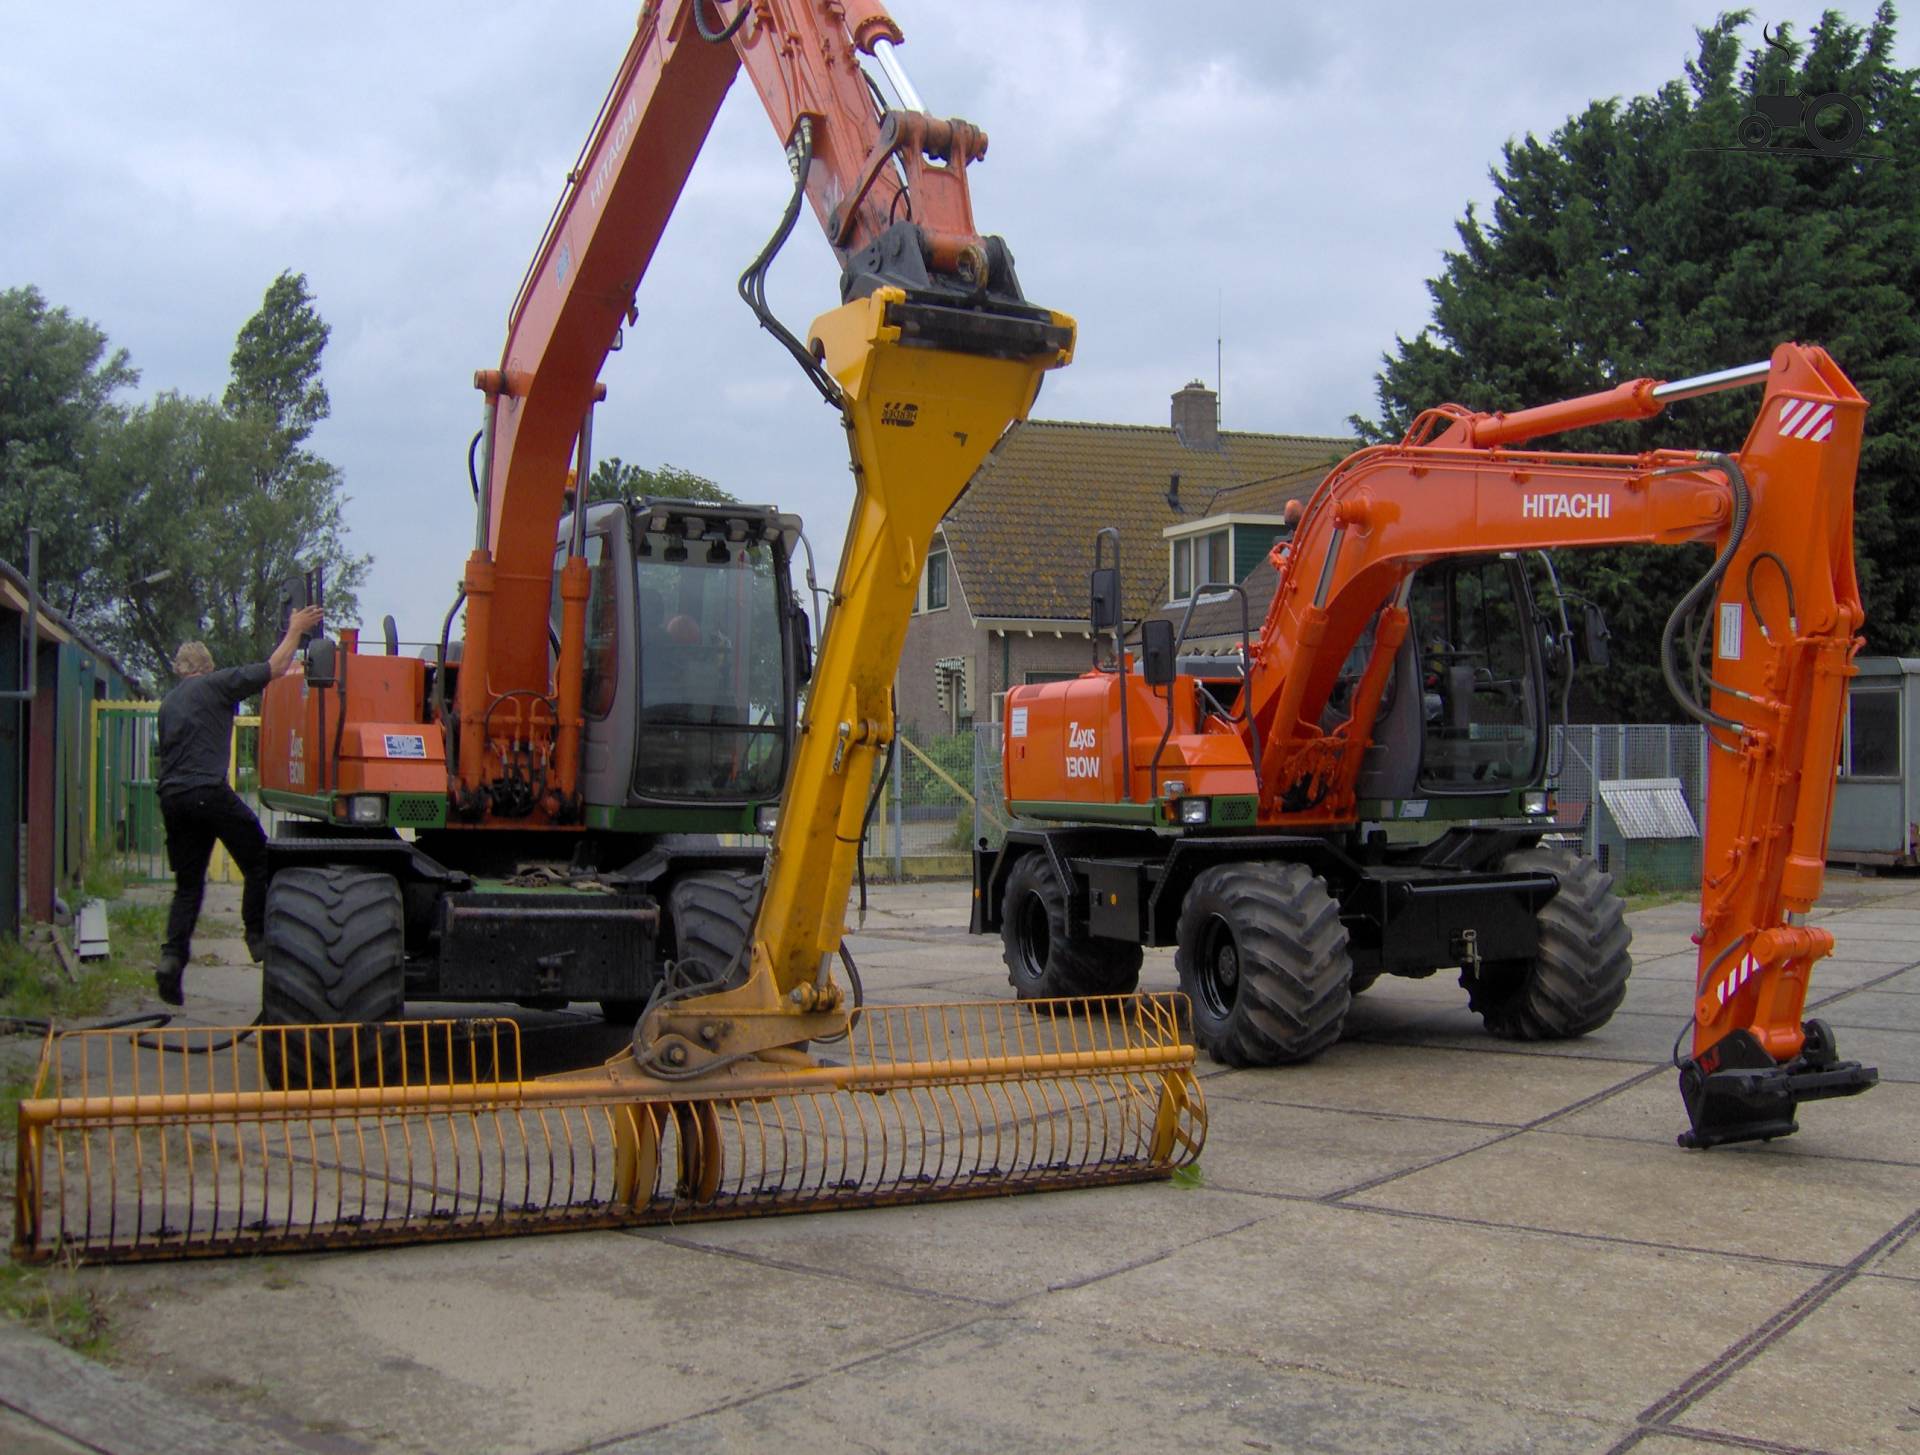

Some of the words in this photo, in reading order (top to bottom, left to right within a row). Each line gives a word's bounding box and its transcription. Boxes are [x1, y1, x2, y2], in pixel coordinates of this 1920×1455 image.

[590, 98, 638, 208] HITACHI
[1522, 493, 1611, 519] HITACHI
[1066, 756, 1101, 779] 130W
